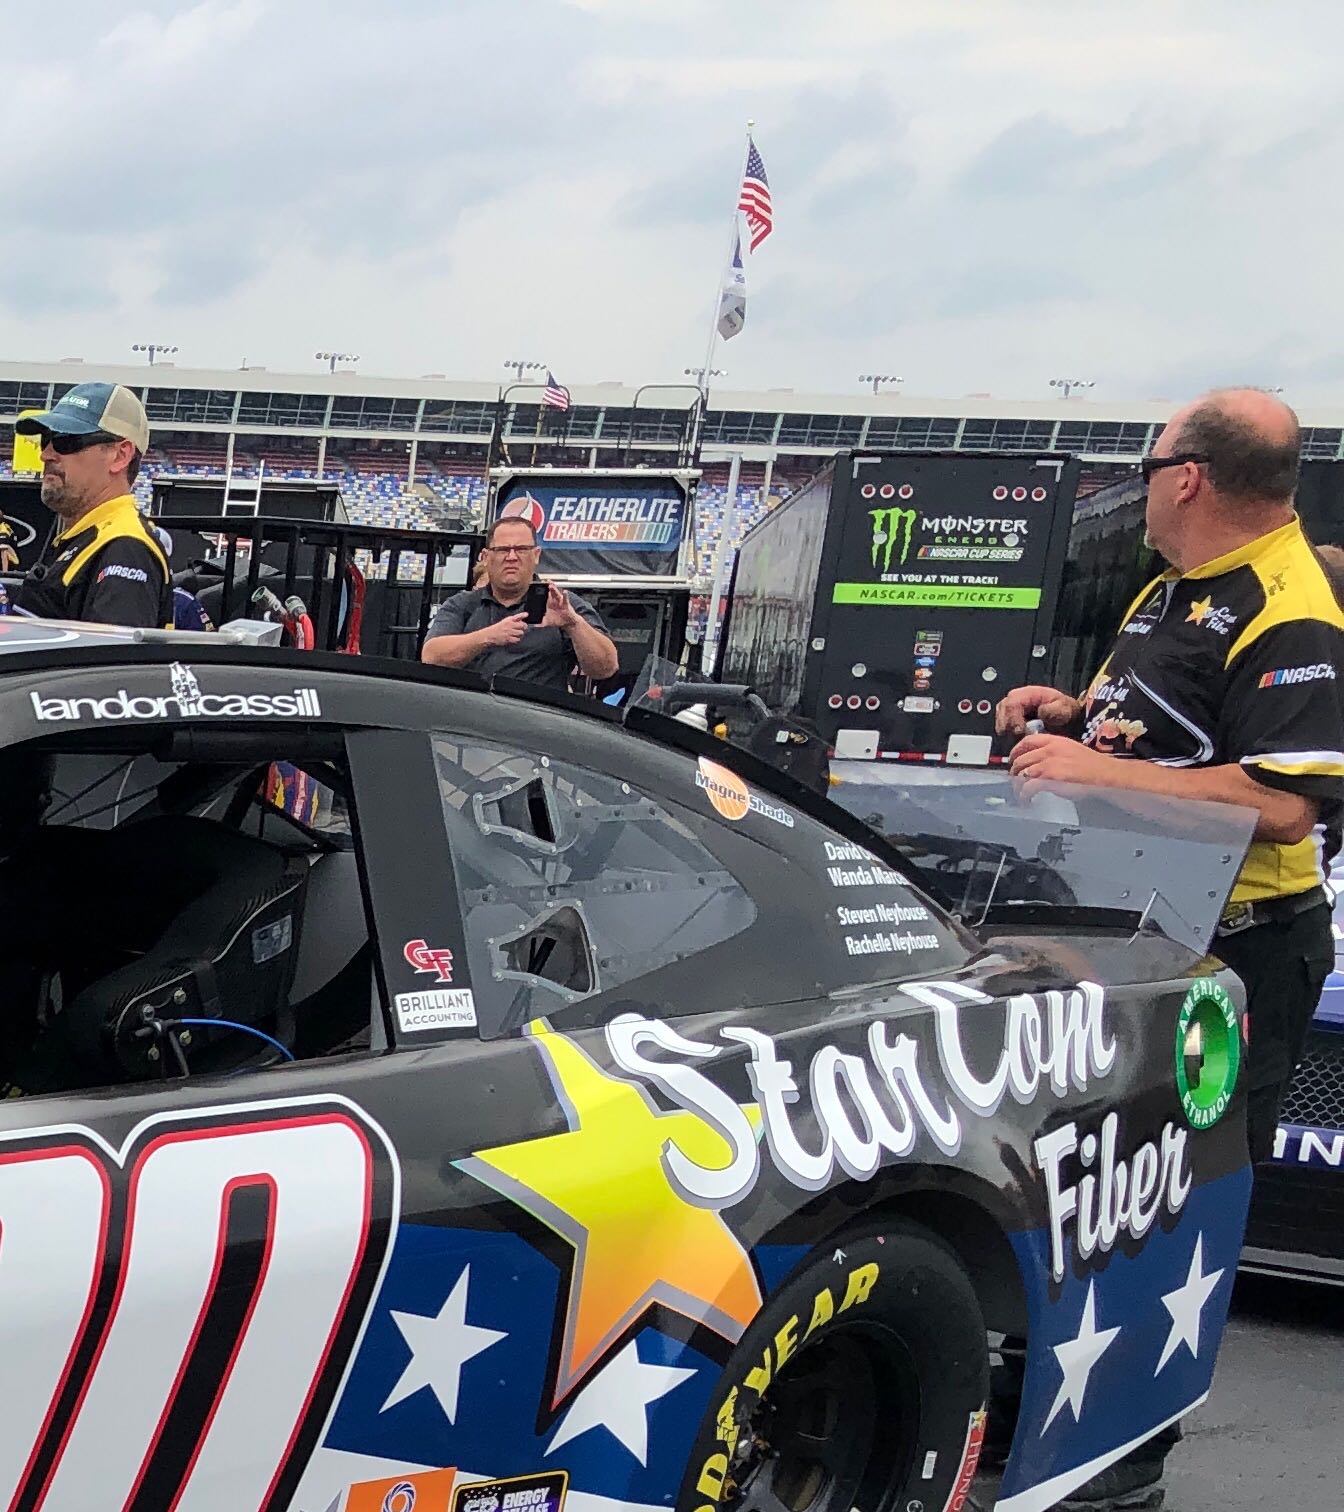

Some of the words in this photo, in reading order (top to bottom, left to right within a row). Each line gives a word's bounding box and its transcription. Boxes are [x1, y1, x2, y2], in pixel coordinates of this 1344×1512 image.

[549, 496, 681, 523] FEATHERLITE
[549, 522, 620, 540] TRAILERS
[922, 515, 1028, 534] MONSTER
[929, 547, 969, 558] NASCAR
[969, 549, 989, 559] CUP
[989, 549, 1023, 560] SERIES
[881, 573, 899, 582] SEE
[901, 574, 922, 583] YOU
[924, 574, 937, 583] AT
[940, 575, 960, 584] THE
[962, 576, 998, 585] TRACK!
[859, 588, 1015, 603] NASCAR.com/TICKETS
[823, 841, 860, 861] David
[826, 867, 872, 888] Wanda
[837, 905, 876, 926] Steven
[877, 902, 929, 926] Neyhouse
[845, 934, 891, 956] Rachelle
[891, 931, 940, 955] Neyhouse
[400, 993, 470, 1013] BRILLIANT
[1179, 979, 1237, 1034] AMERICAN
[405, 1012, 473, 1026] ACCOUNTING
[1183, 1091, 1231, 1126] ETHANOL
[1034, 1112, 1192, 1284] Fiber
[502, 1487, 551, 1510] ENERGY
